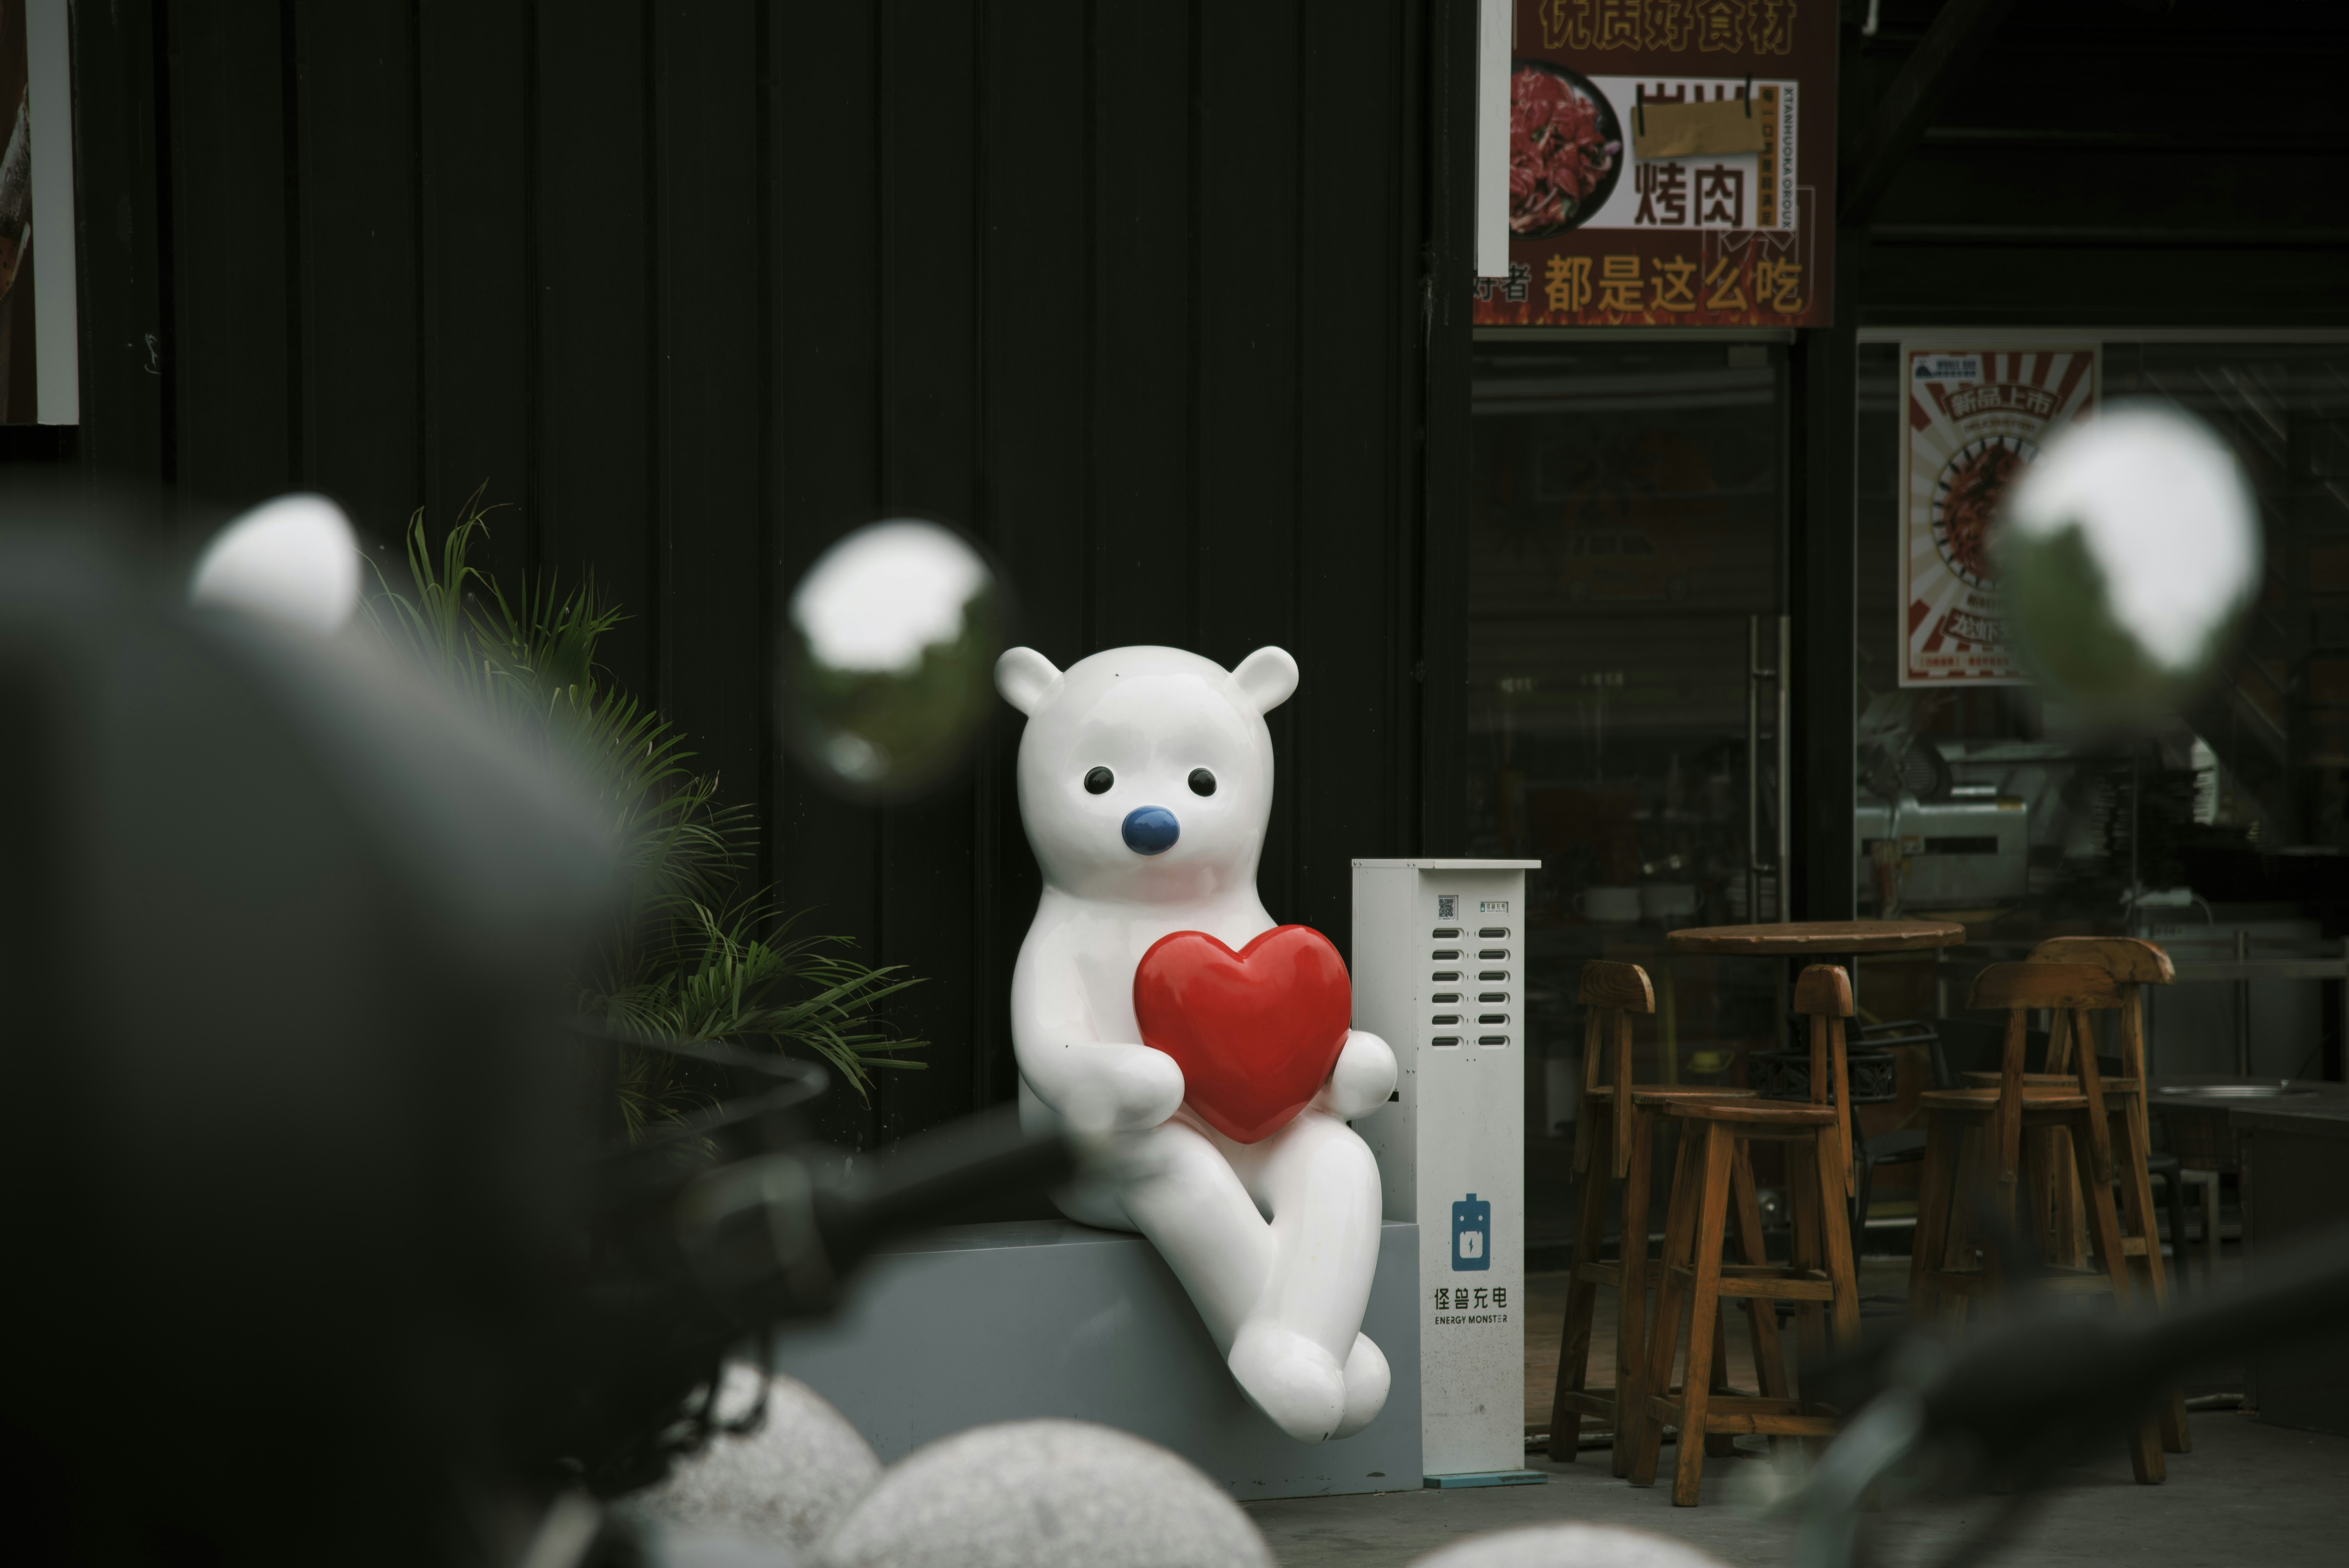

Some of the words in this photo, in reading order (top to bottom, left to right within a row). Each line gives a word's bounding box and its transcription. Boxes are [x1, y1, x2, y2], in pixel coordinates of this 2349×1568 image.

[1539, 0, 1798, 55] 优质好食材
[1634, 162, 1744, 228] 烤肉
[1544, 254, 1802, 314] 都是这么吃
[1950, 386, 2053, 417] 新品上市
[1435, 1287, 1507, 1310] 怪兽充电
[1435, 1316, 1466, 1325] ENERGY
[1469, 1314, 1508, 1324] MONSTER
